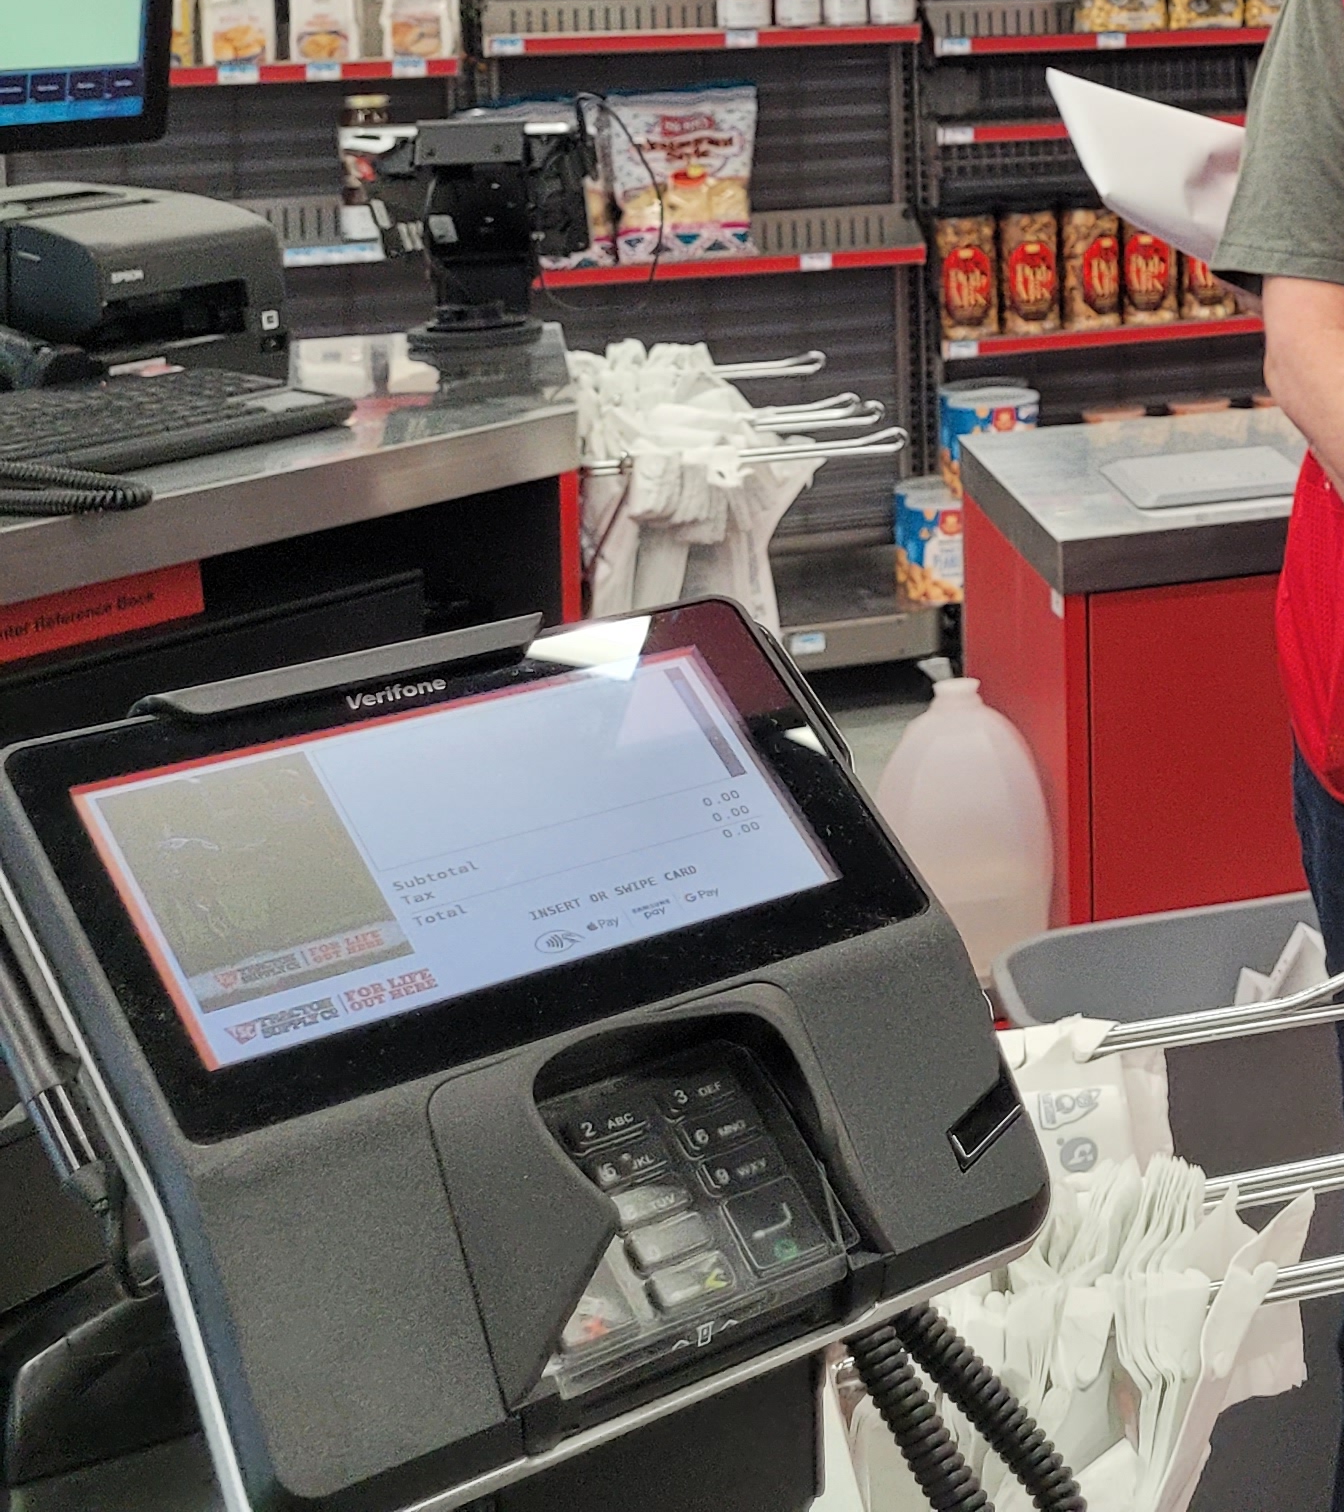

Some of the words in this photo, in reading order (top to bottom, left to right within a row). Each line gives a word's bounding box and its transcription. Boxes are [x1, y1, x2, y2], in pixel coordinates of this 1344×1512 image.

[346, 677, 447, 711] Verifone
[702, 789, 741, 807] 0.00
[712, 804, 751, 823] 0.00
[722, 820, 761, 839] 0.00
[392, 861, 479, 891] Subtotal
[401, 890, 435, 906] Tax
[528, 898, 582, 922] INSERT
[591, 890, 609, 904] OR
[614, 876, 658, 897] SWIPE
[663, 864, 698, 884] CARD
[412, 905, 467, 927] Total
[597, 915, 620, 931] Pay
[643, 906, 667, 921] pay
[344, 983, 386, 1002] FOR
[387, 968, 433, 990] LIFE
[350, 992, 389, 1013] OUT
[674, 1089, 688, 1104] 3
[581, 1121, 597, 1137] 2
[607, 1112, 635, 1130] ABC
[694, 1129, 709, 1145] 6
[715, 1168, 730, 1184] 9
